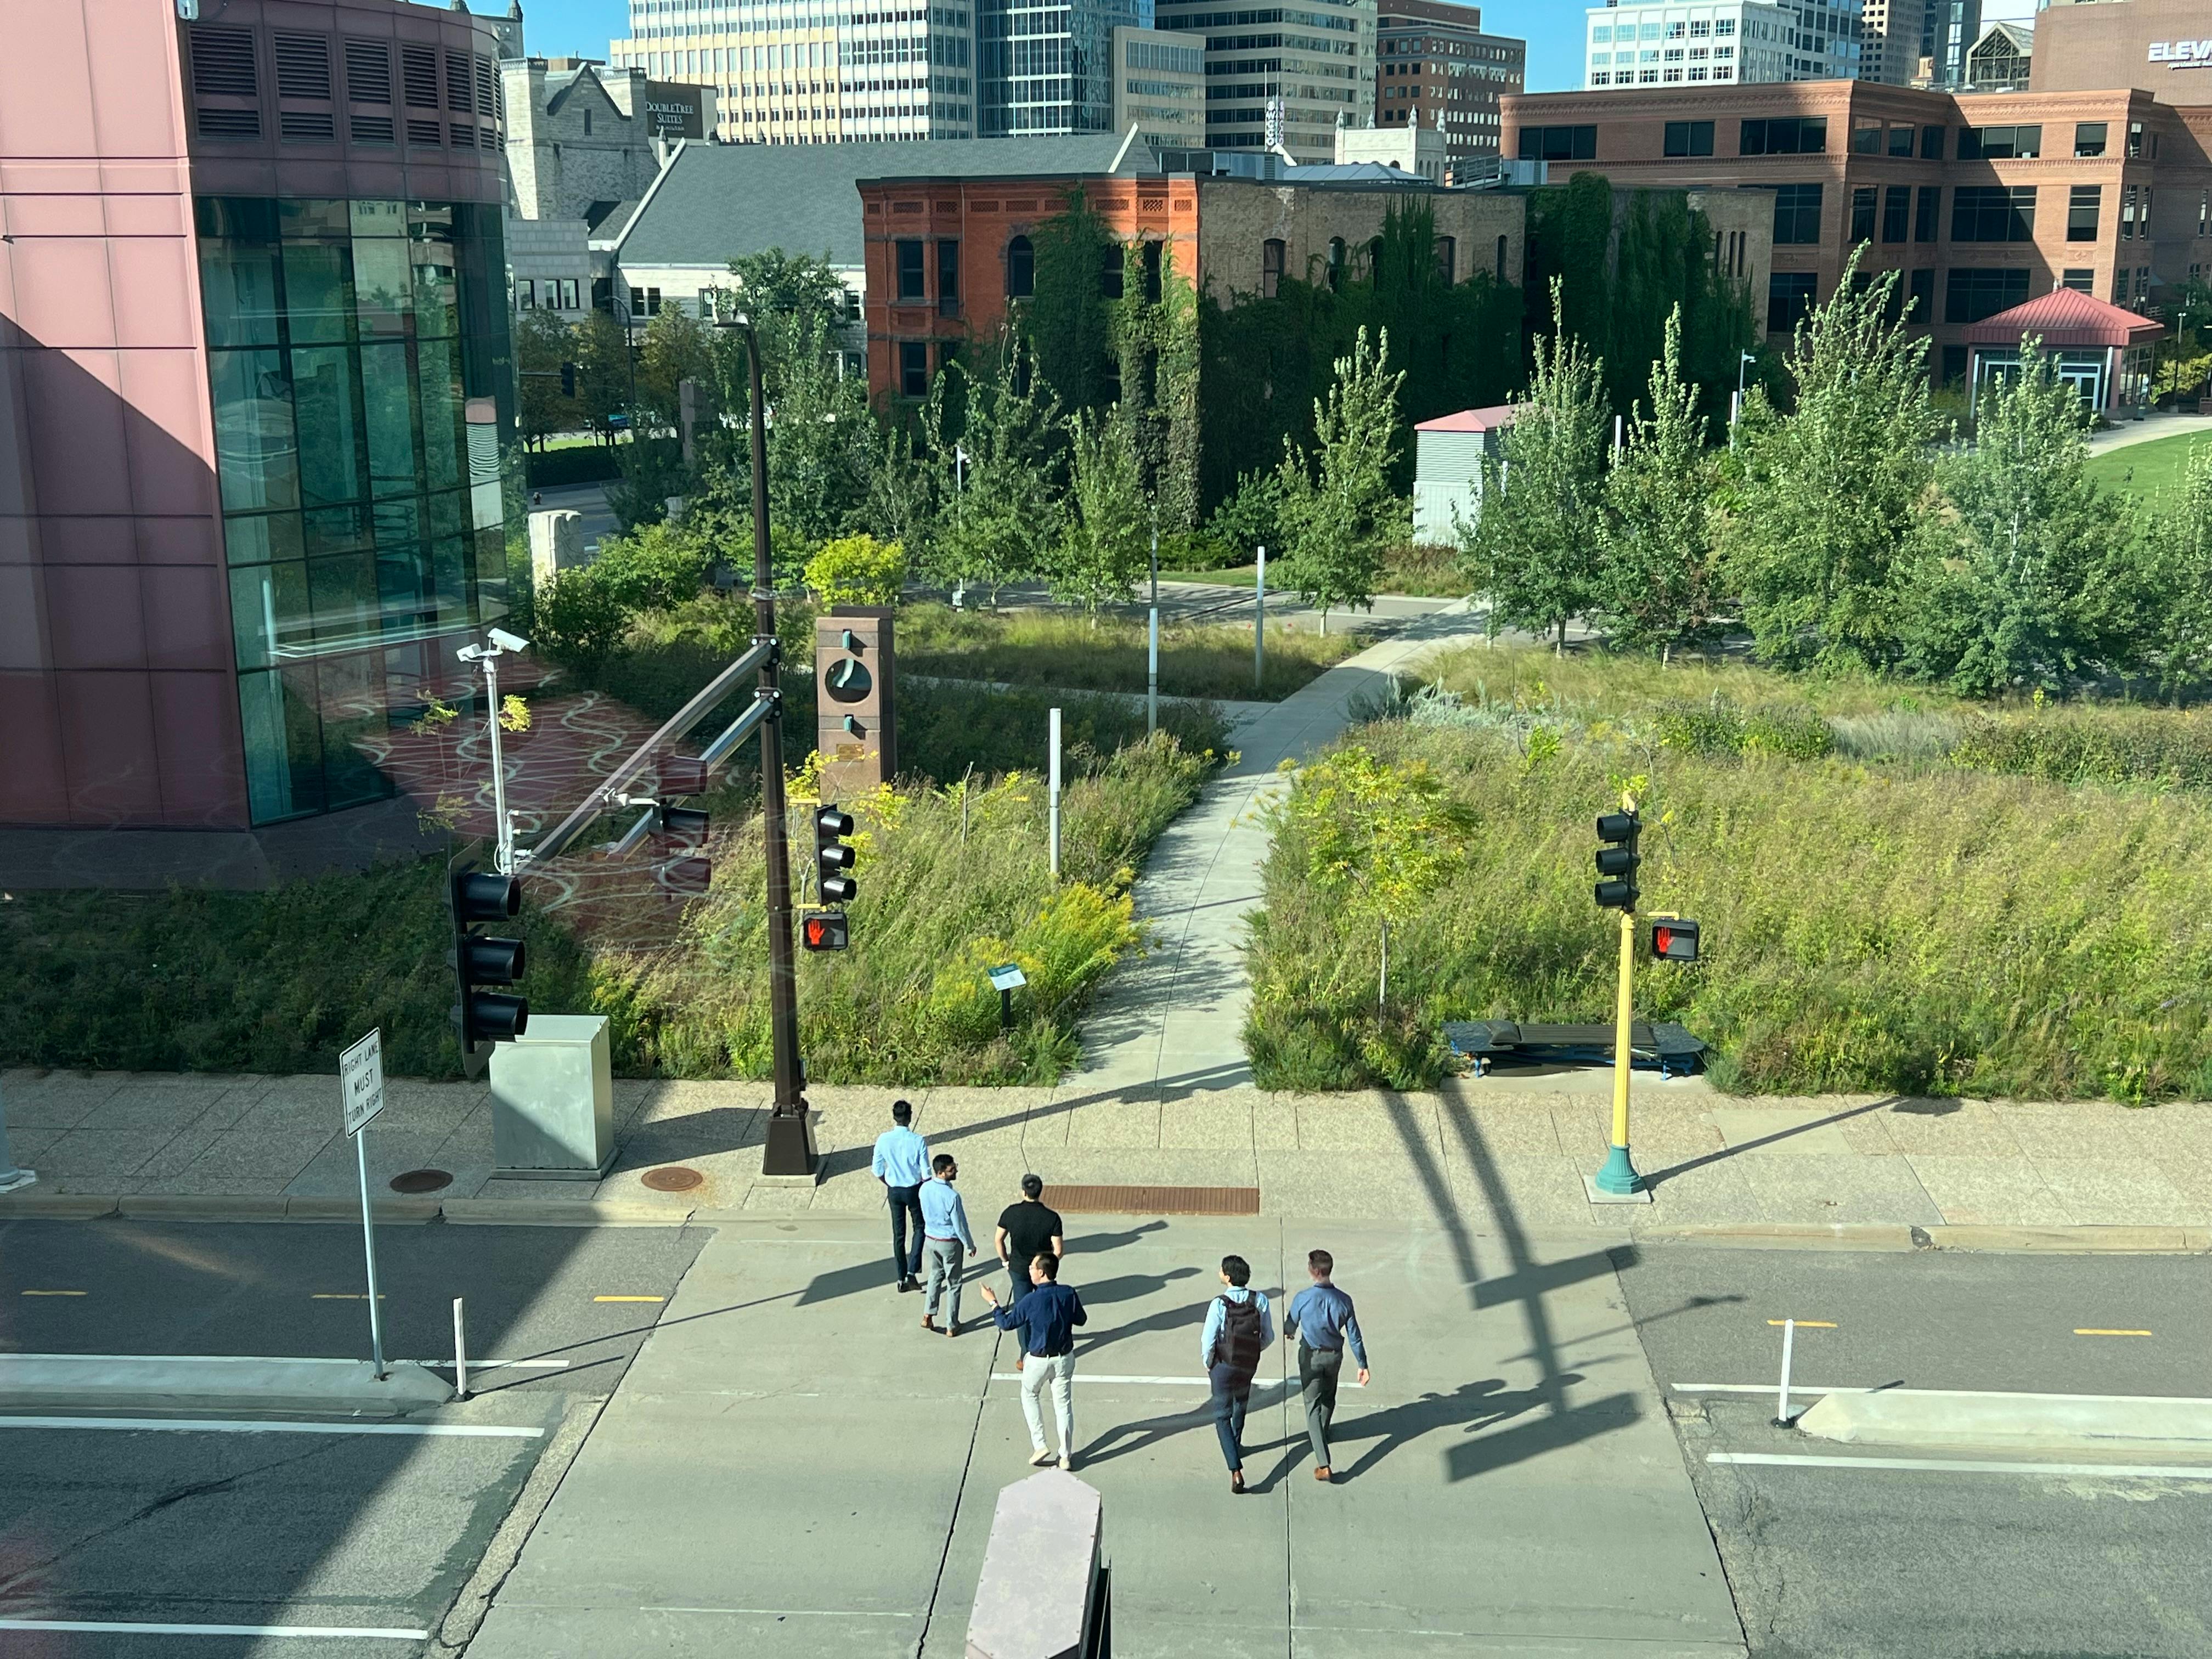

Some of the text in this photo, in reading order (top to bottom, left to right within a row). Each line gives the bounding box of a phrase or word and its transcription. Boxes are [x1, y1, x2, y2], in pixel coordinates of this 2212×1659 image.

[657, 114, 682, 124] SUITES
[1266, 111, 1276, 146] WCCO
[343, 1040, 379, 1077] RIGHT LANE
[354, 1069, 374, 1097] MUST
[348, 1088, 382, 1125] TURN RIGHT
